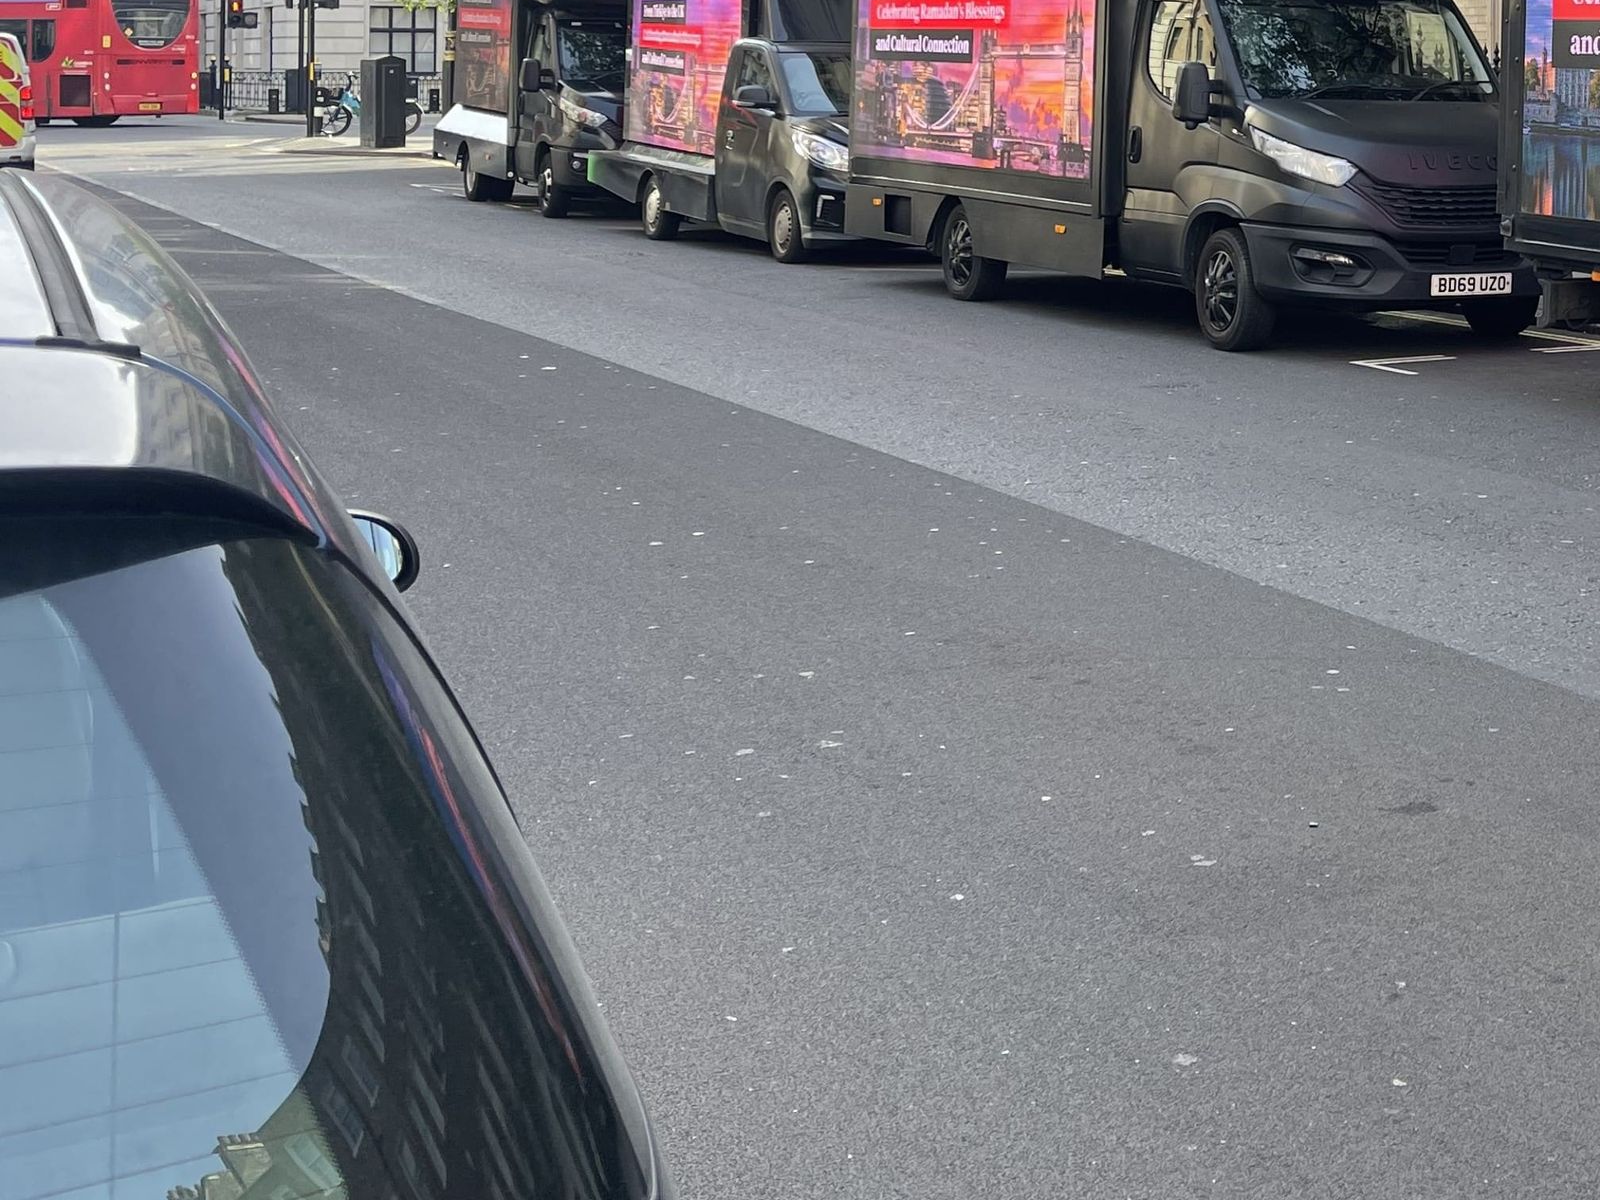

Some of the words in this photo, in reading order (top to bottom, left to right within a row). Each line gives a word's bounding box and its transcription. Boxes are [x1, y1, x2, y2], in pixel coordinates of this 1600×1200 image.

[875, 34, 891, 52] and
[922, 35, 970, 54] Connection
[1438, 277, 1477, 293] BD69
[1479, 275, 1507, 292] UZO
